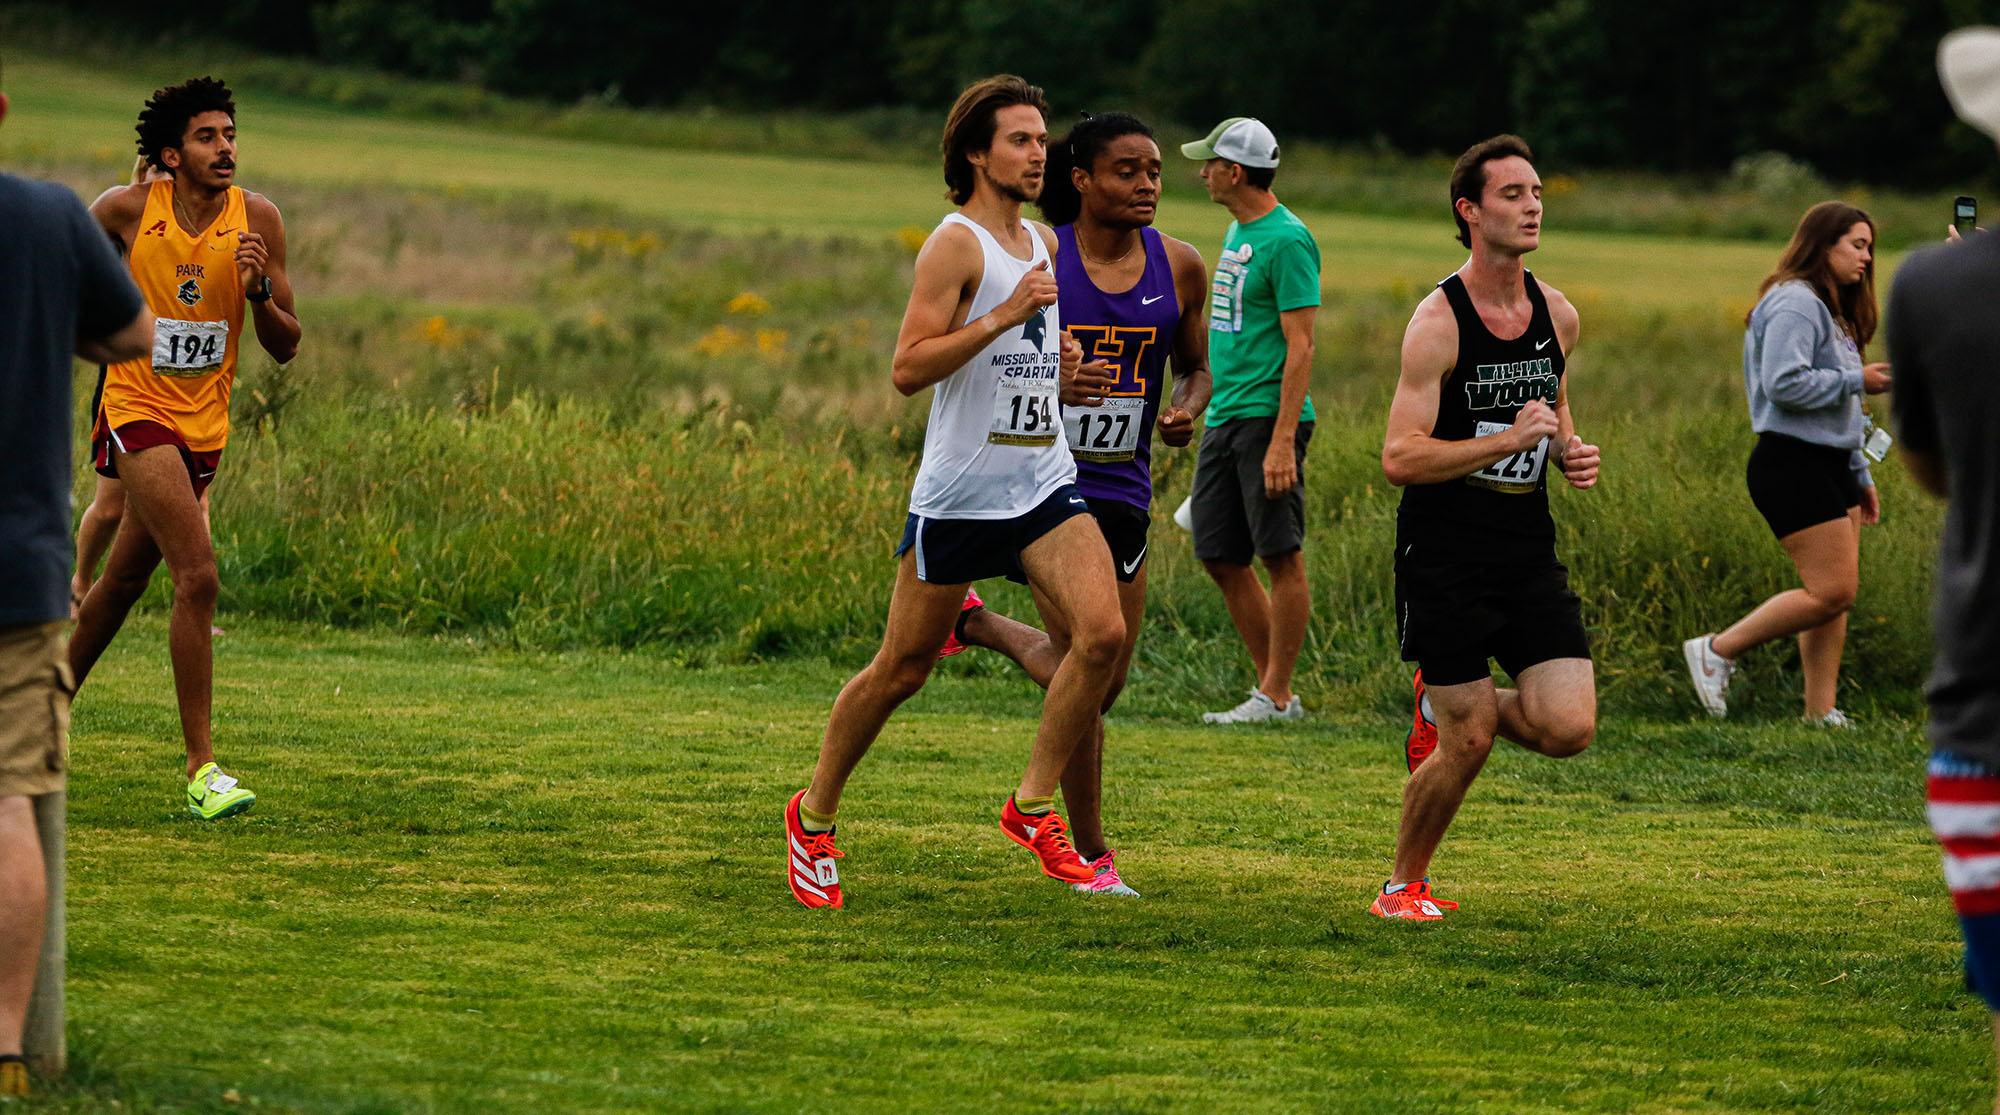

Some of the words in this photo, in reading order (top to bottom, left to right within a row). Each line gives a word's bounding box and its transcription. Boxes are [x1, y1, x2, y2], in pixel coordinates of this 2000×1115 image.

[176, 264, 205, 279] PARK
[169, 334, 216, 364] 194
[991, 352, 1039, 367] MISSOURI
[1477, 357, 1552, 382] WILLIAM
[1465, 374, 1559, 411] WOODS
[1010, 395, 1052, 432] 154
[1078, 413, 1131, 448] 127
